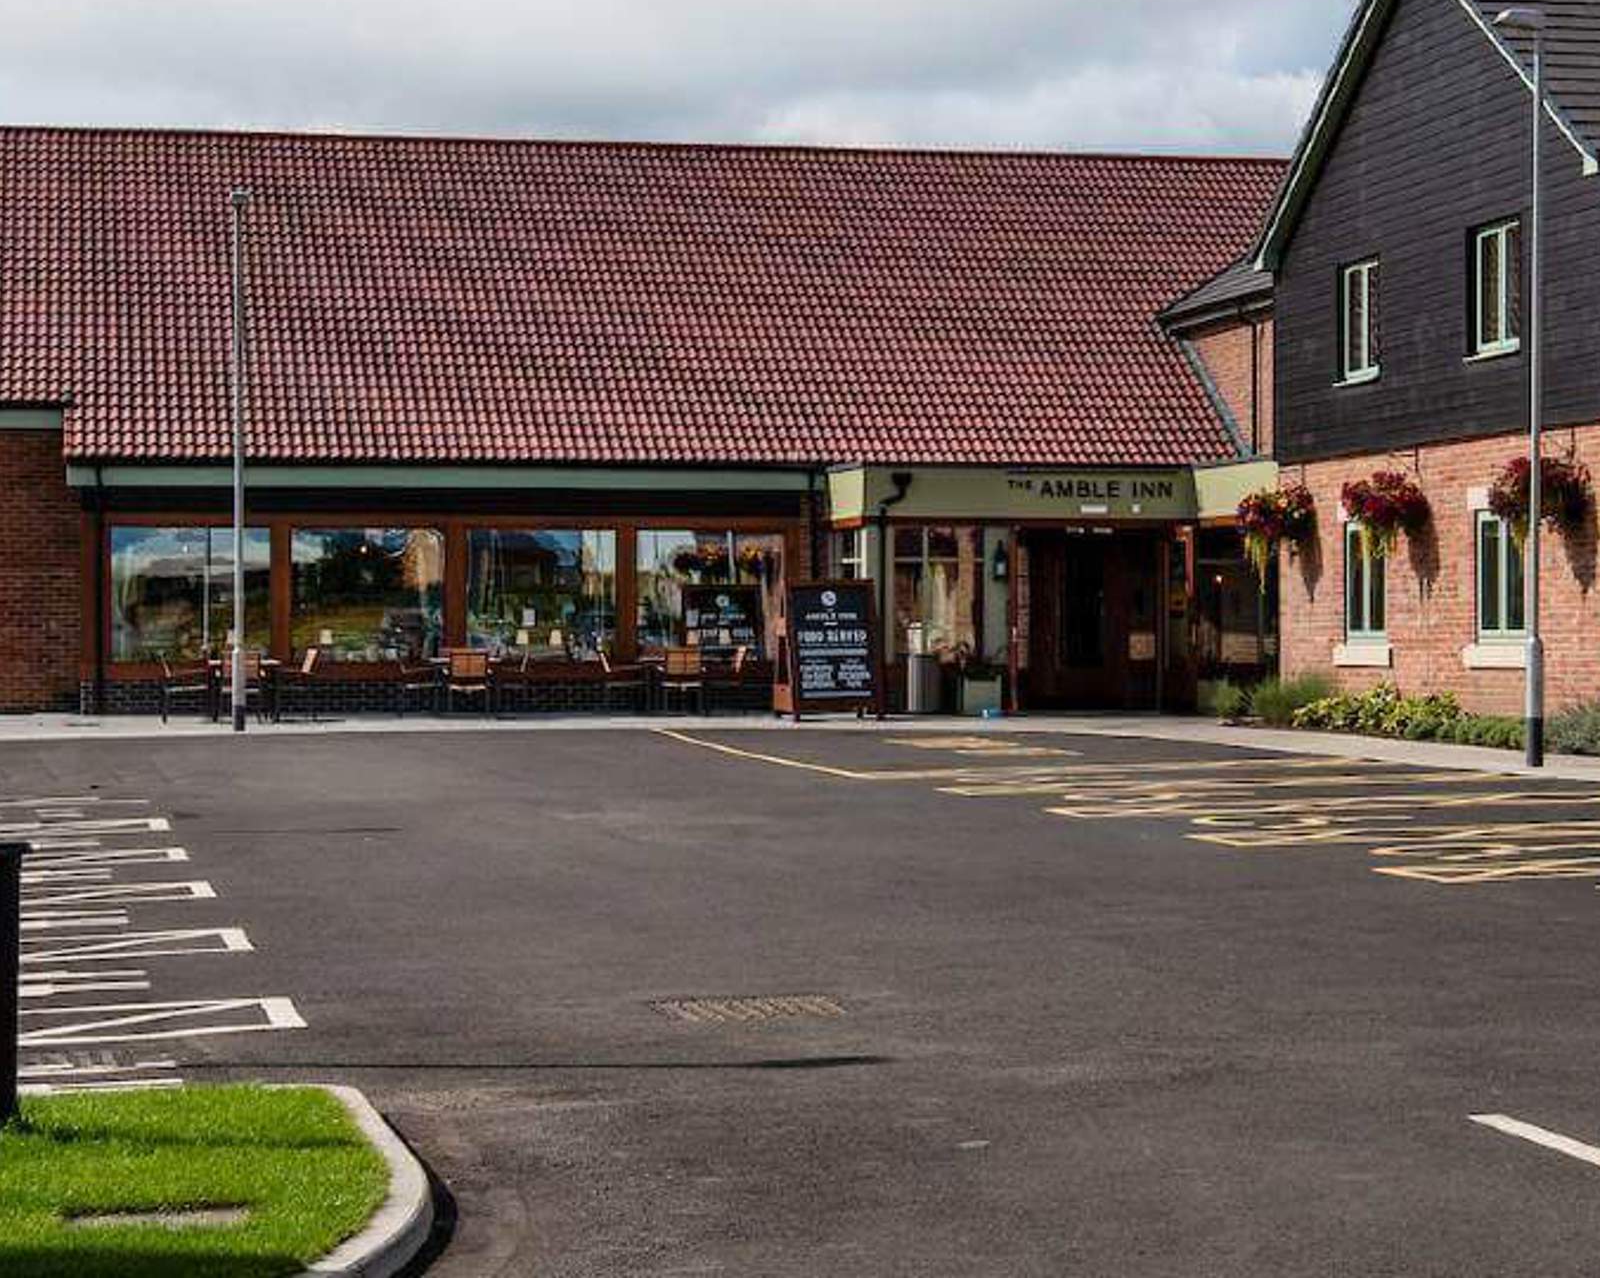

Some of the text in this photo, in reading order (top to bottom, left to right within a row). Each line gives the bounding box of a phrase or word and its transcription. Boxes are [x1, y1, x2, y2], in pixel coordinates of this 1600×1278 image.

[1008, 480, 1173, 498] THE AMBLE INN
